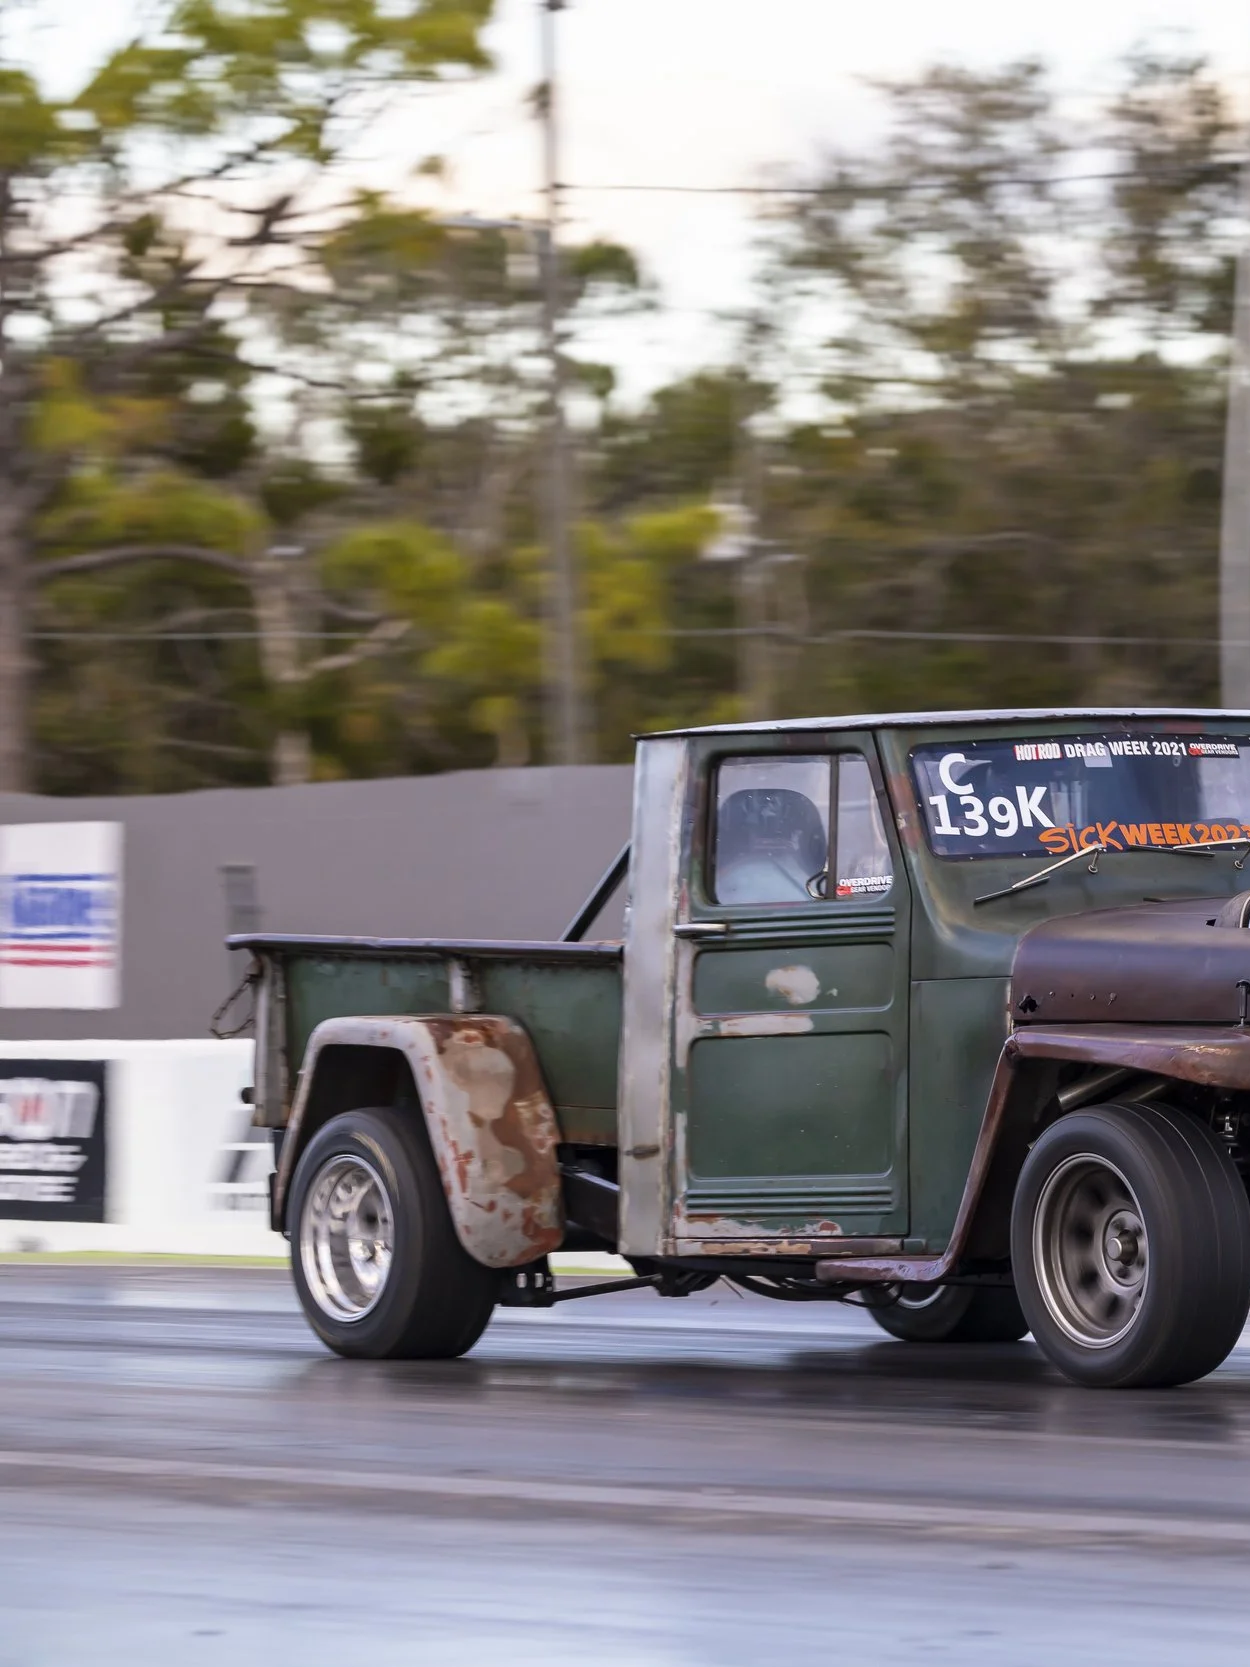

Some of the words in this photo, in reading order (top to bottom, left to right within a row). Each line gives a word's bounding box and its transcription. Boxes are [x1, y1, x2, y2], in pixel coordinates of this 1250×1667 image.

[1015, 744, 1037, 760] HOT
[1037, 743, 1061, 760] ROD
[1064, 743, 1107, 758] DRAG
[1108, 741, 1151, 756] WEEK
[1152, 741, 1187, 756] 2021
[939, 752, 974, 795] C
[929, 786, 1055, 837] 139K
[839, 875, 893, 887] OVERDRIVE
